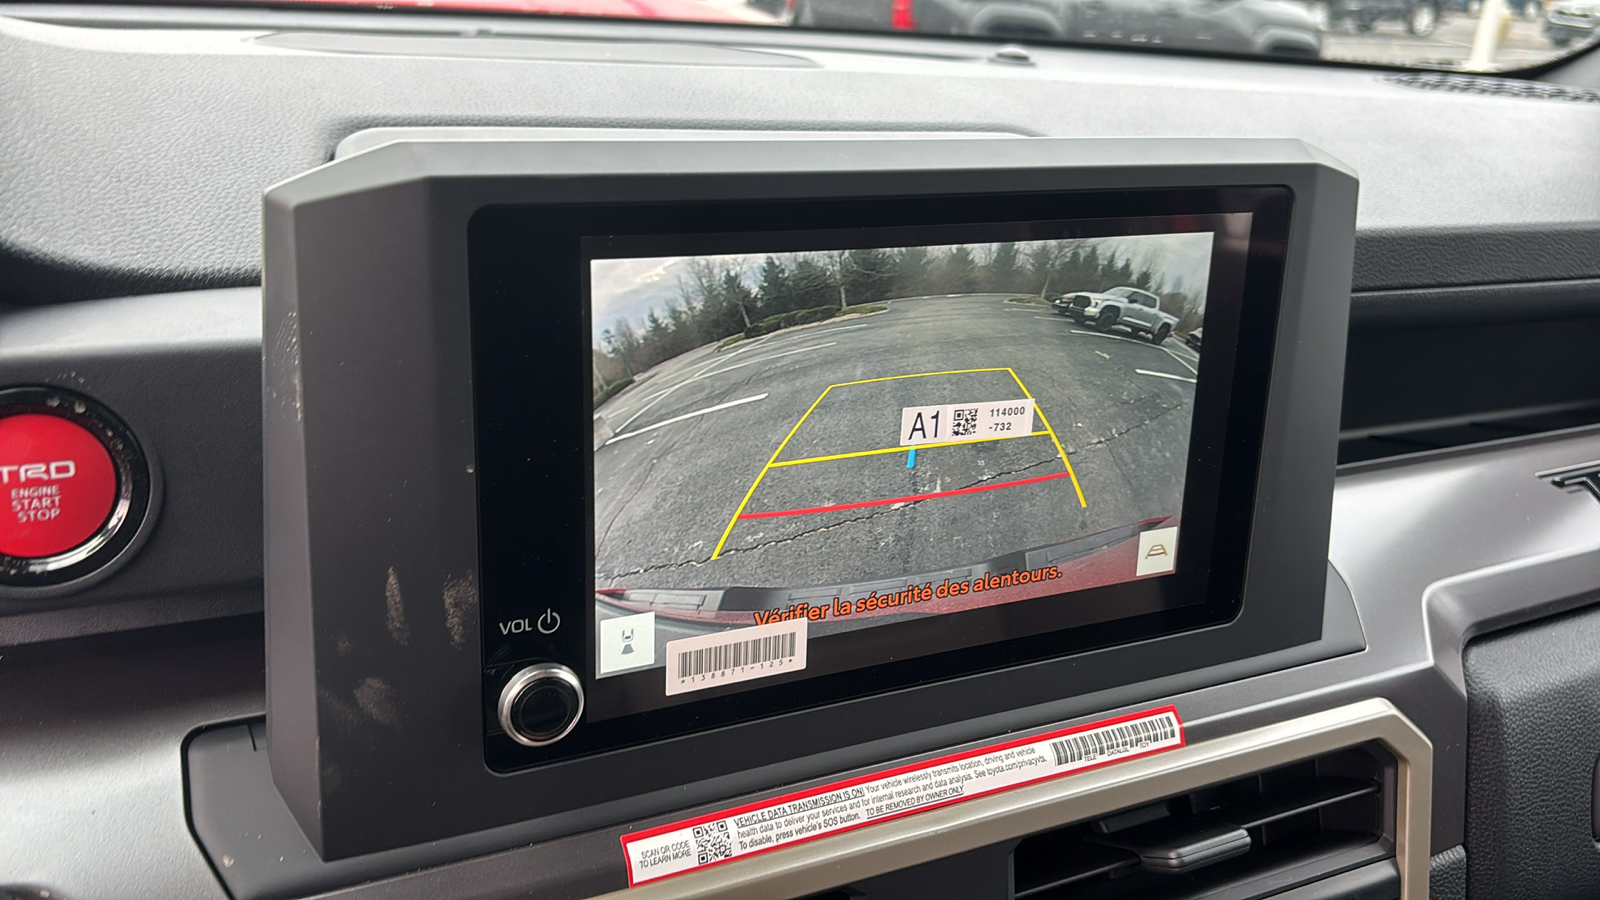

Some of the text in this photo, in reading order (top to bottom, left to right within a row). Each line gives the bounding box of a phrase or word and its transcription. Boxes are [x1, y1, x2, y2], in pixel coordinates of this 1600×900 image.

[989, 406, 1026, 418] 114000
[908, 410, 940, 440] A1
[989, 422, 1012, 432] -732
[0, 460, 76, 484] TRD
[11, 484, 61, 499] ENGINE
[12, 495, 62, 512] START
[17, 508, 61, 524] STOP
[753, 565, 1063, 626] Vérifier la sécurité des alentours.
[499, 618, 533, 635] VOL
[734, 745, 1035, 827] VEHICLE DATA TRANSMISSION IS ON! Your vehicle wirelessly transmits location, driving and vehicle
[737, 826, 758, 839] health
[759, 821, 774, 833] data
[775, 820, 782, 829] to
[784, 814, 805, 826] deliver
[807, 811, 820, 822] your
[822, 803, 847, 817] services
[849, 800, 860, 810] and
[862, 797, 870, 806] for
[871, 791, 893, 804] internal
[895, 784, 921, 798] research
[922, 781, 933, 791] and
[935, 777, 947, 788] data
[949, 771, 973, 786] analysis.
[974, 767, 986, 778] See
[866, 784, 964, 816] TO BE REMOVED BY OWNER ONLY
[739, 810, 860, 850] To disable, press vehicle's SOS button.
[640, 847, 691, 869] TO LEARN MORE
[641, 847, 660, 859] SCAN
[672, 839, 690, 851] CODE
